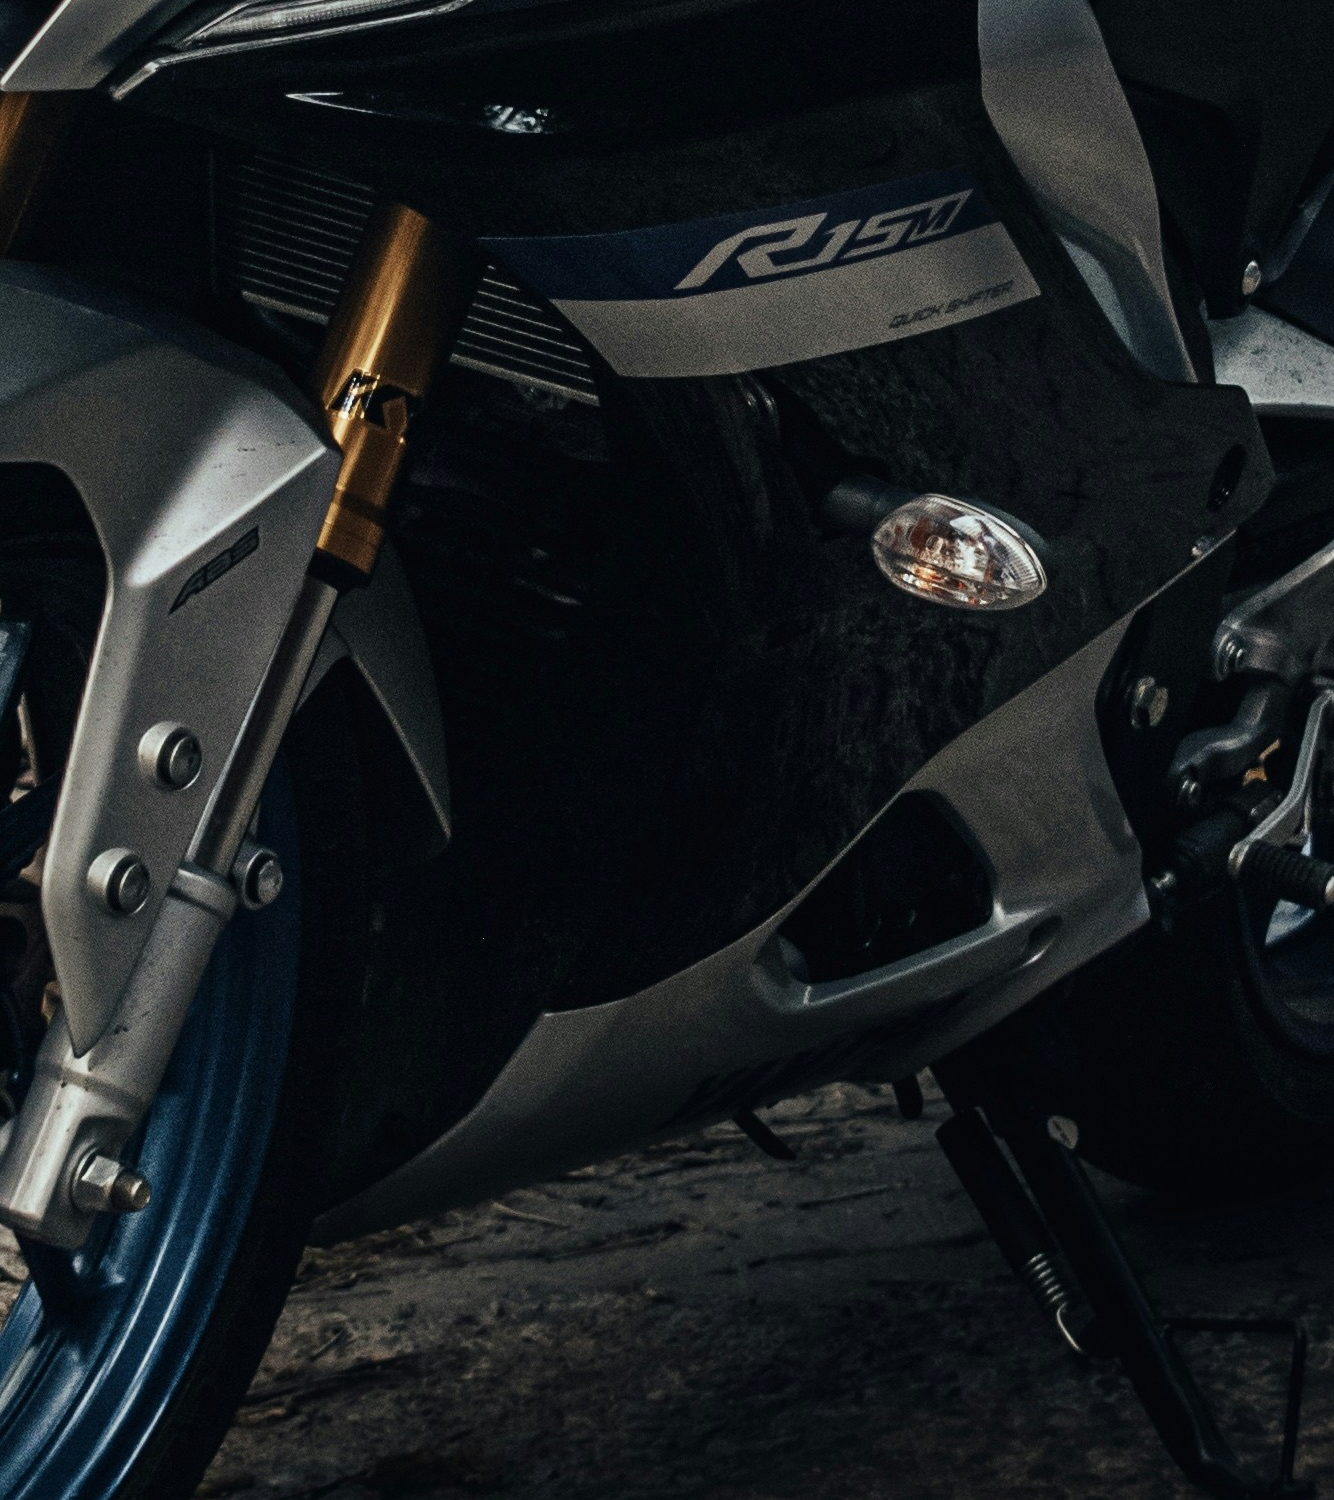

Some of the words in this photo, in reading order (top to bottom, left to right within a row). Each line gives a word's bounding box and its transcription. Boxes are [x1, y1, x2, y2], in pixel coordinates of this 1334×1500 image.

[673, 188, 973, 290] R15M
[888, 303, 944, 329] QUICK
[169, 525, 260, 615] ABS
